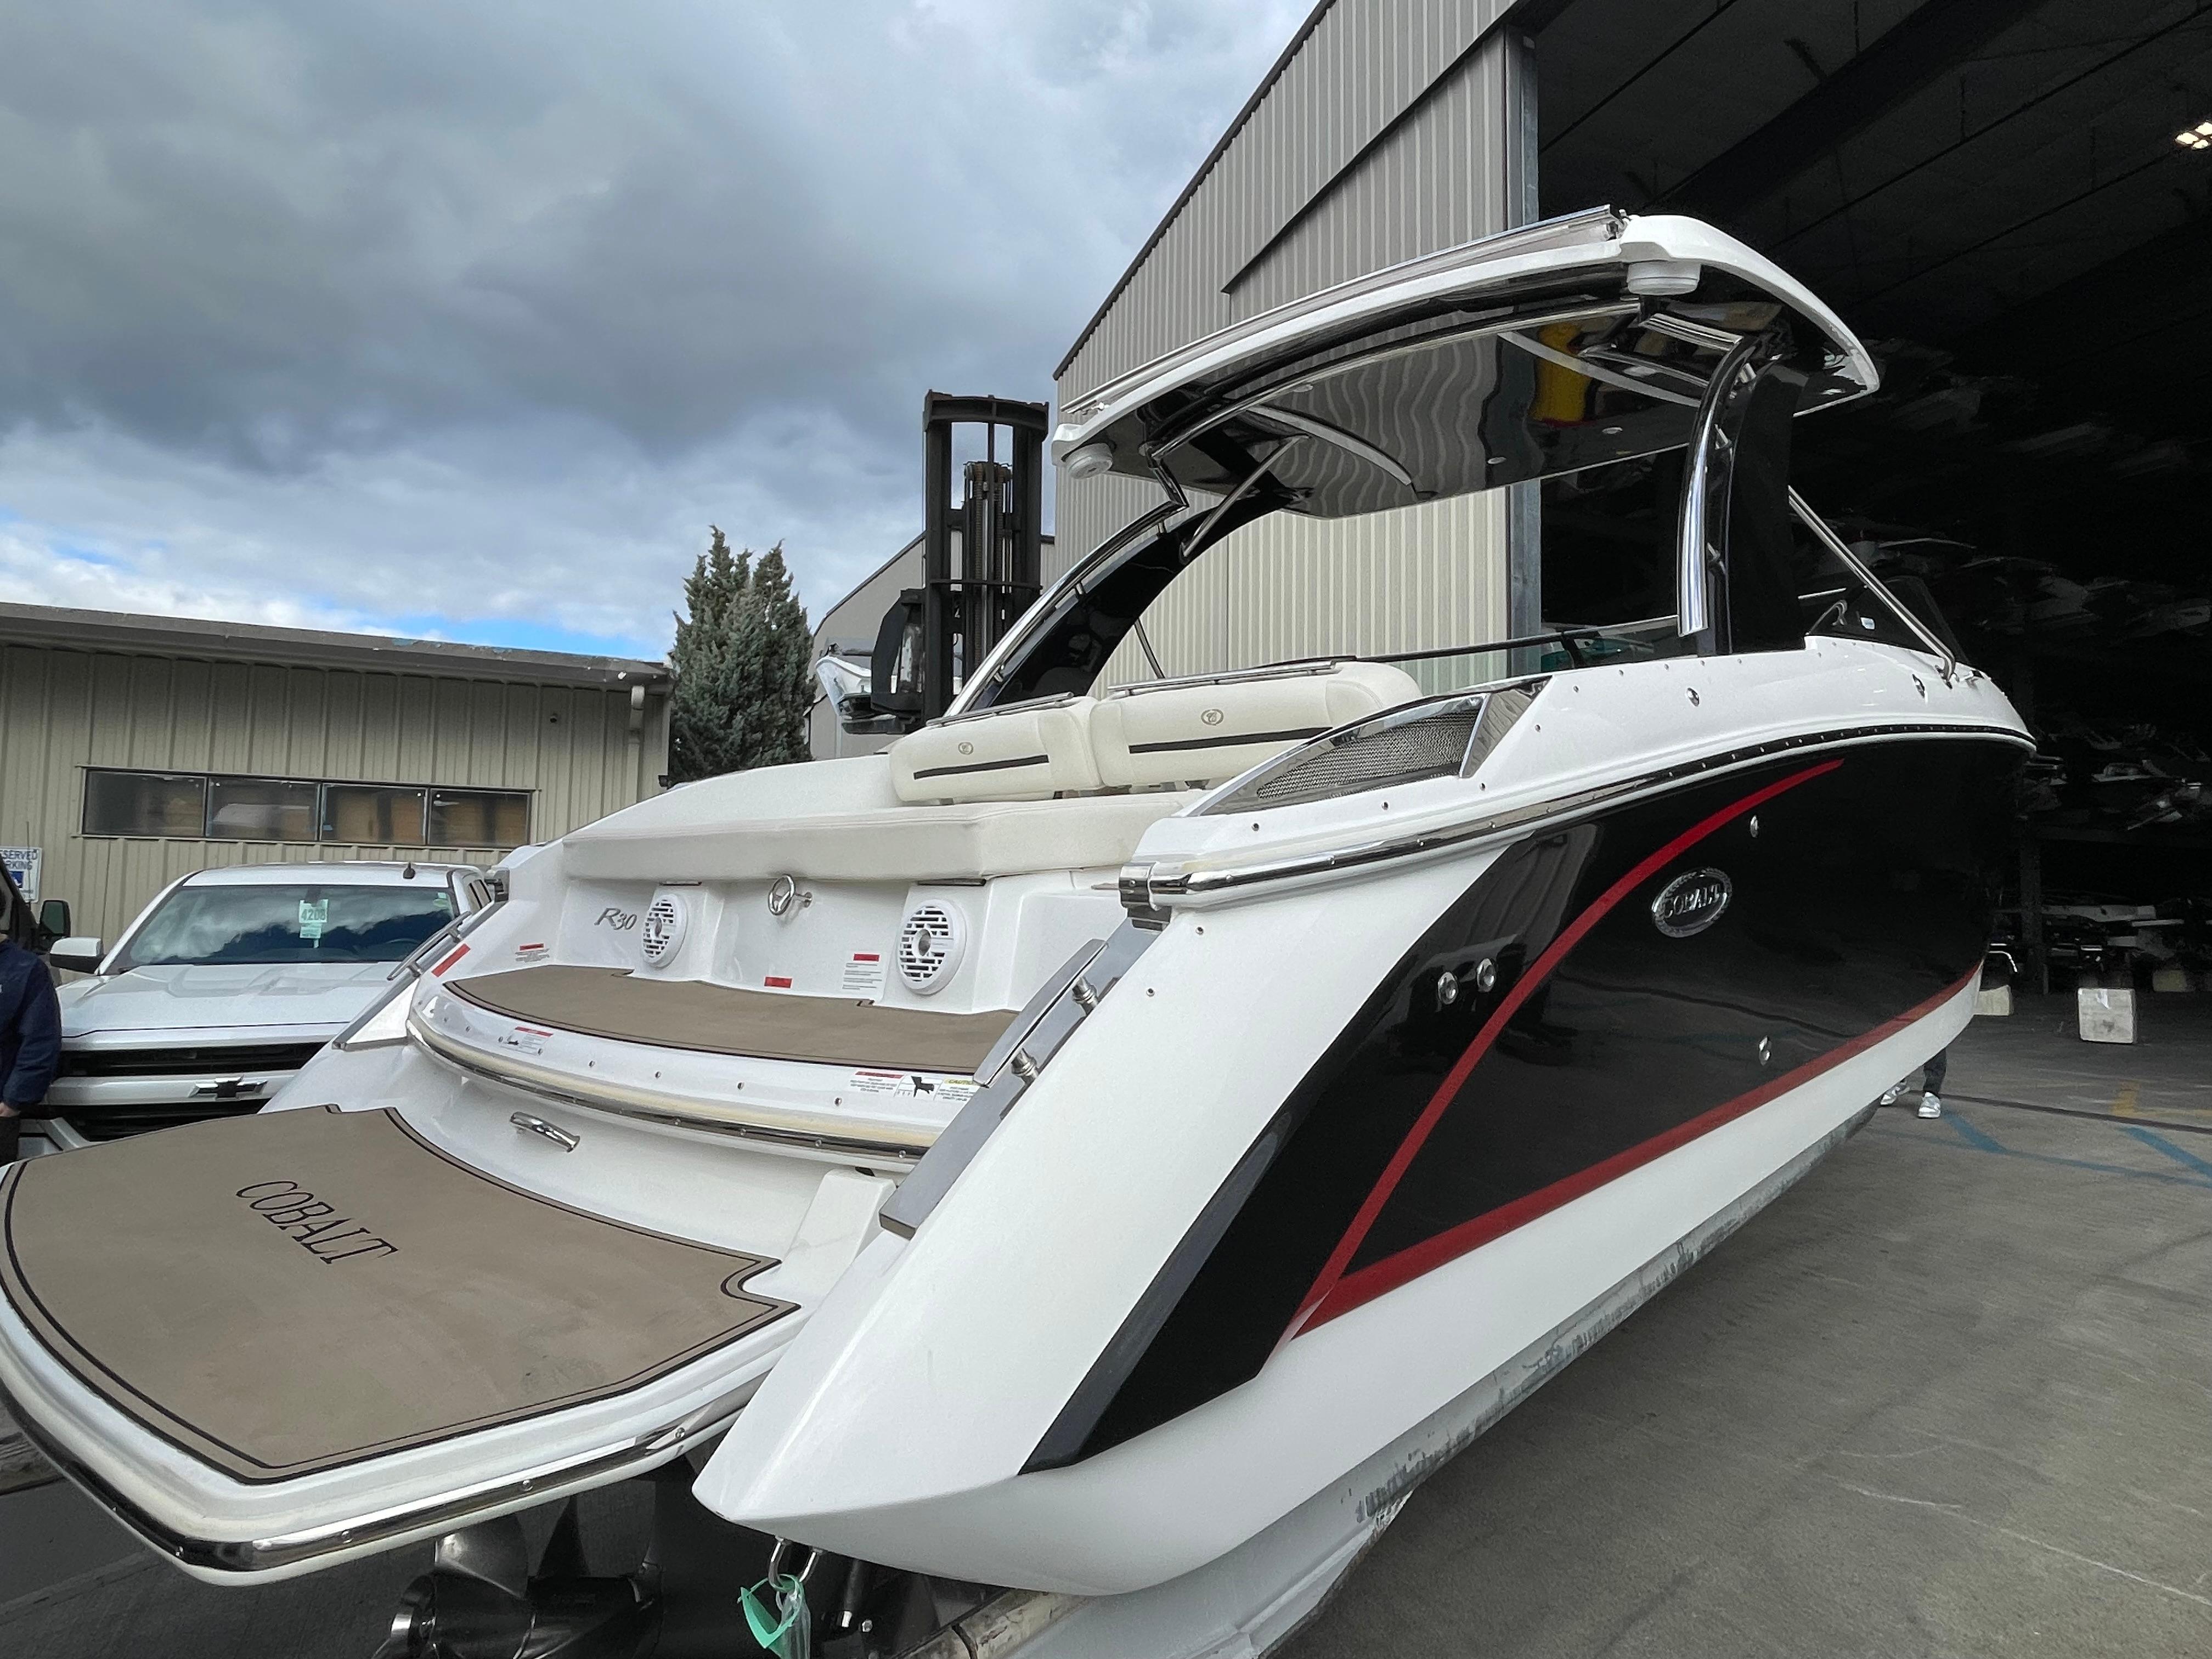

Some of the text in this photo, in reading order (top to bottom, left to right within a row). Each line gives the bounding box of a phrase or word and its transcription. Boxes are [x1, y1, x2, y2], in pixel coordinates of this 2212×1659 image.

[0, 850, 37, 860] SERVED
[594, 907, 637, 930] R30
[236, 1181, 399, 1265] COBALT
